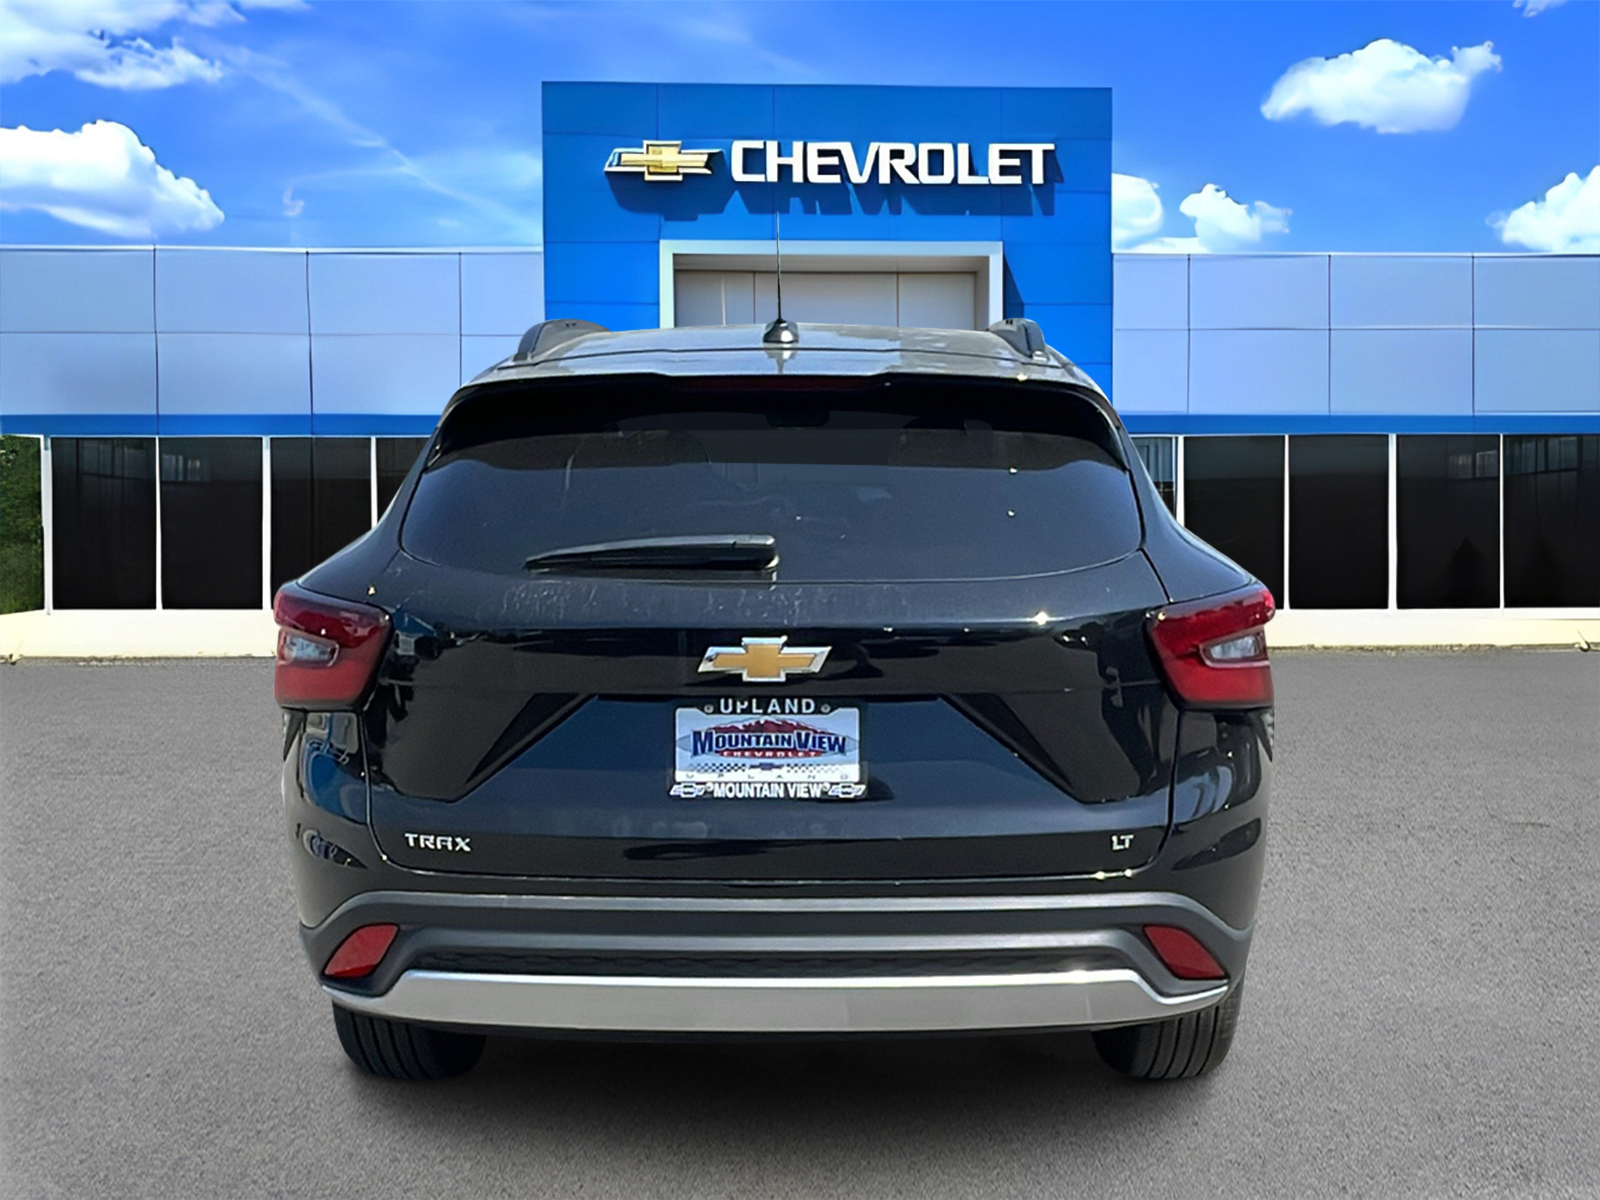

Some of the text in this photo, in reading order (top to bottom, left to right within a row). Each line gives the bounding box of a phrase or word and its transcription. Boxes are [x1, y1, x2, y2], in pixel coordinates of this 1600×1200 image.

[731, 140, 1055, 185] CHEVROLET
[719, 698, 816, 714] UPLAND
[713, 782, 822, 798] MOUNTAIN VIEW
[404, 832, 471, 851] TRAX
[1111, 834, 1134, 850] LT
